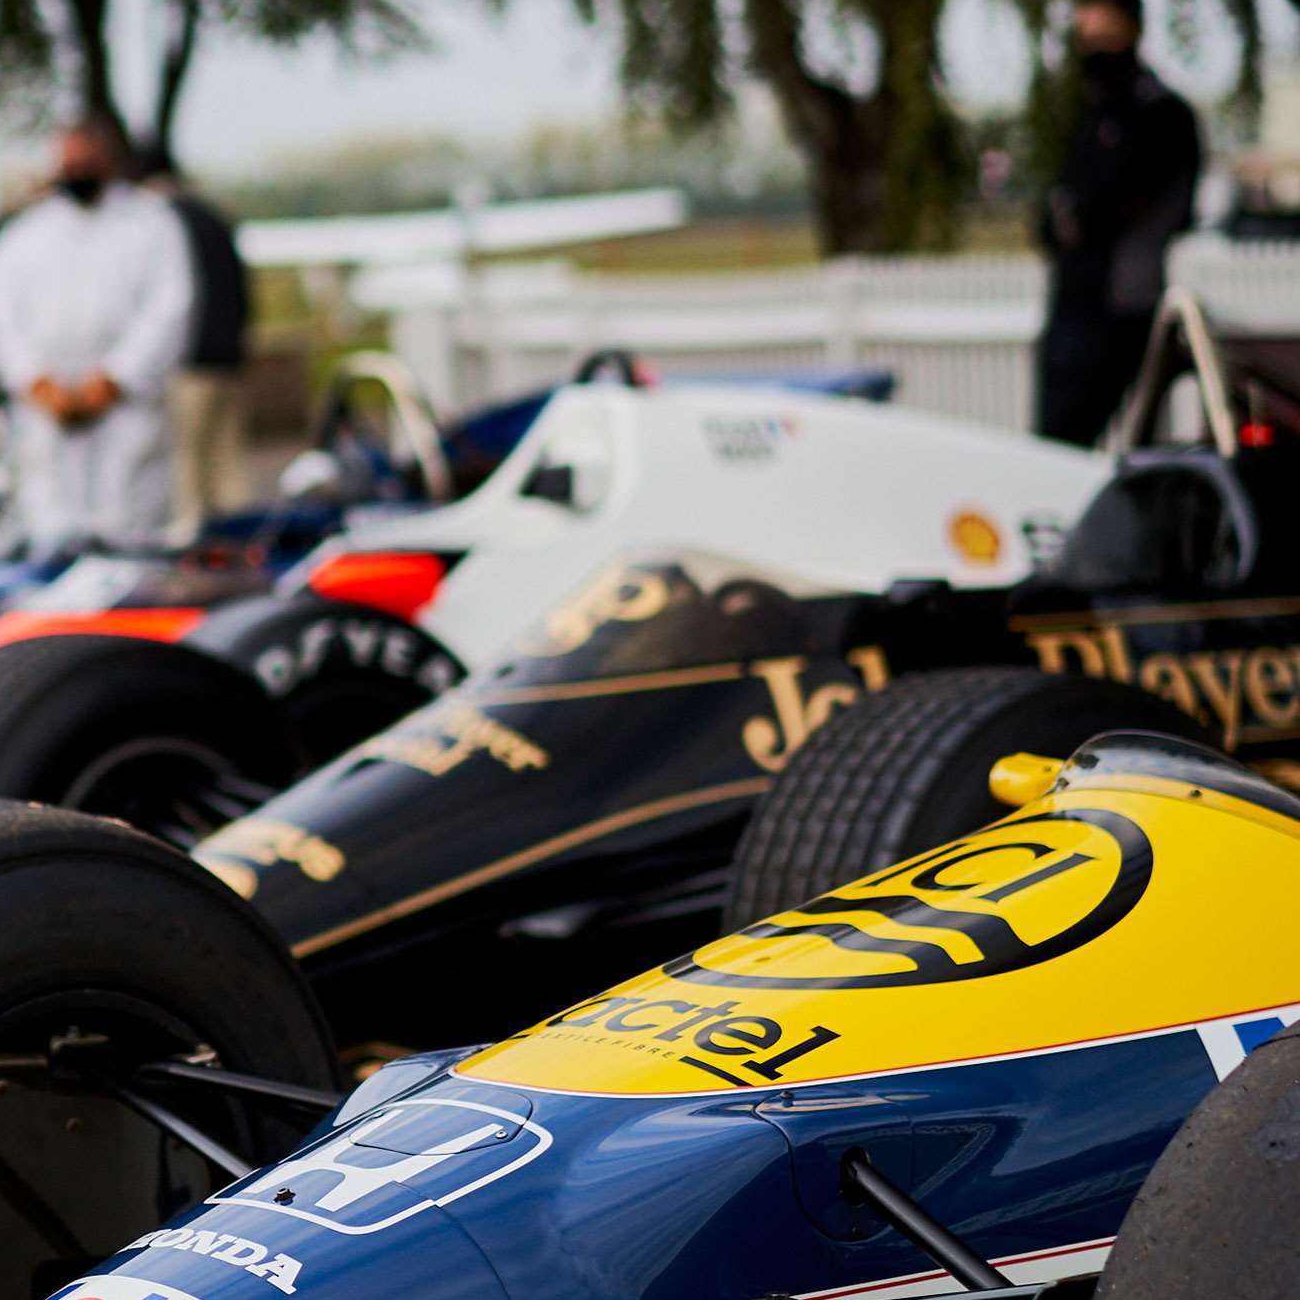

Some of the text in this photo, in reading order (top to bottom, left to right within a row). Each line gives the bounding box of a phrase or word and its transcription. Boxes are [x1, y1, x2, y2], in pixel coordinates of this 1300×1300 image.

[863, 841, 1098, 904] ICI
[546, 991, 842, 1082] actel
[611, 1039, 676, 1059] FIBRE
